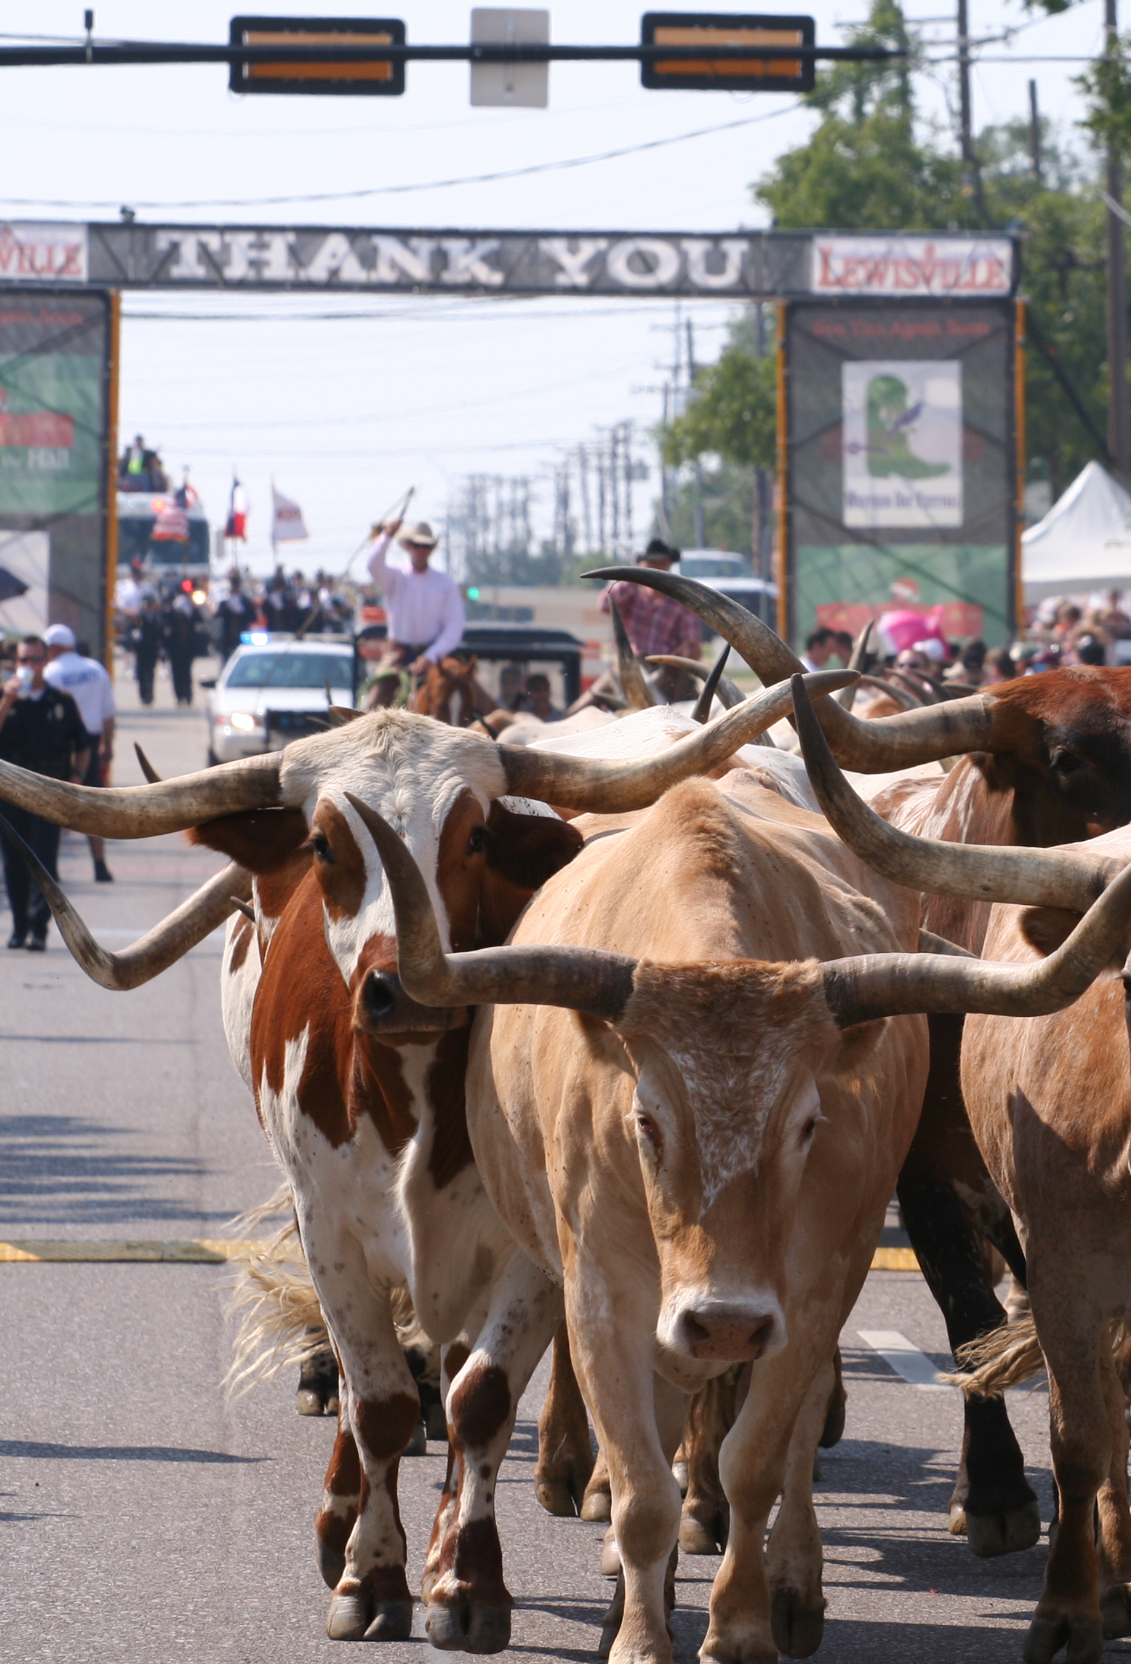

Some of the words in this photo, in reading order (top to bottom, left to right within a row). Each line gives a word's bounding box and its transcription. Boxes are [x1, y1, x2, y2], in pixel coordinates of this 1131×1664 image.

[156, 232, 504, 287] THANK
[538, 237, 750, 289] YOU
[818, 243, 1009, 289] LEWISVILLE
